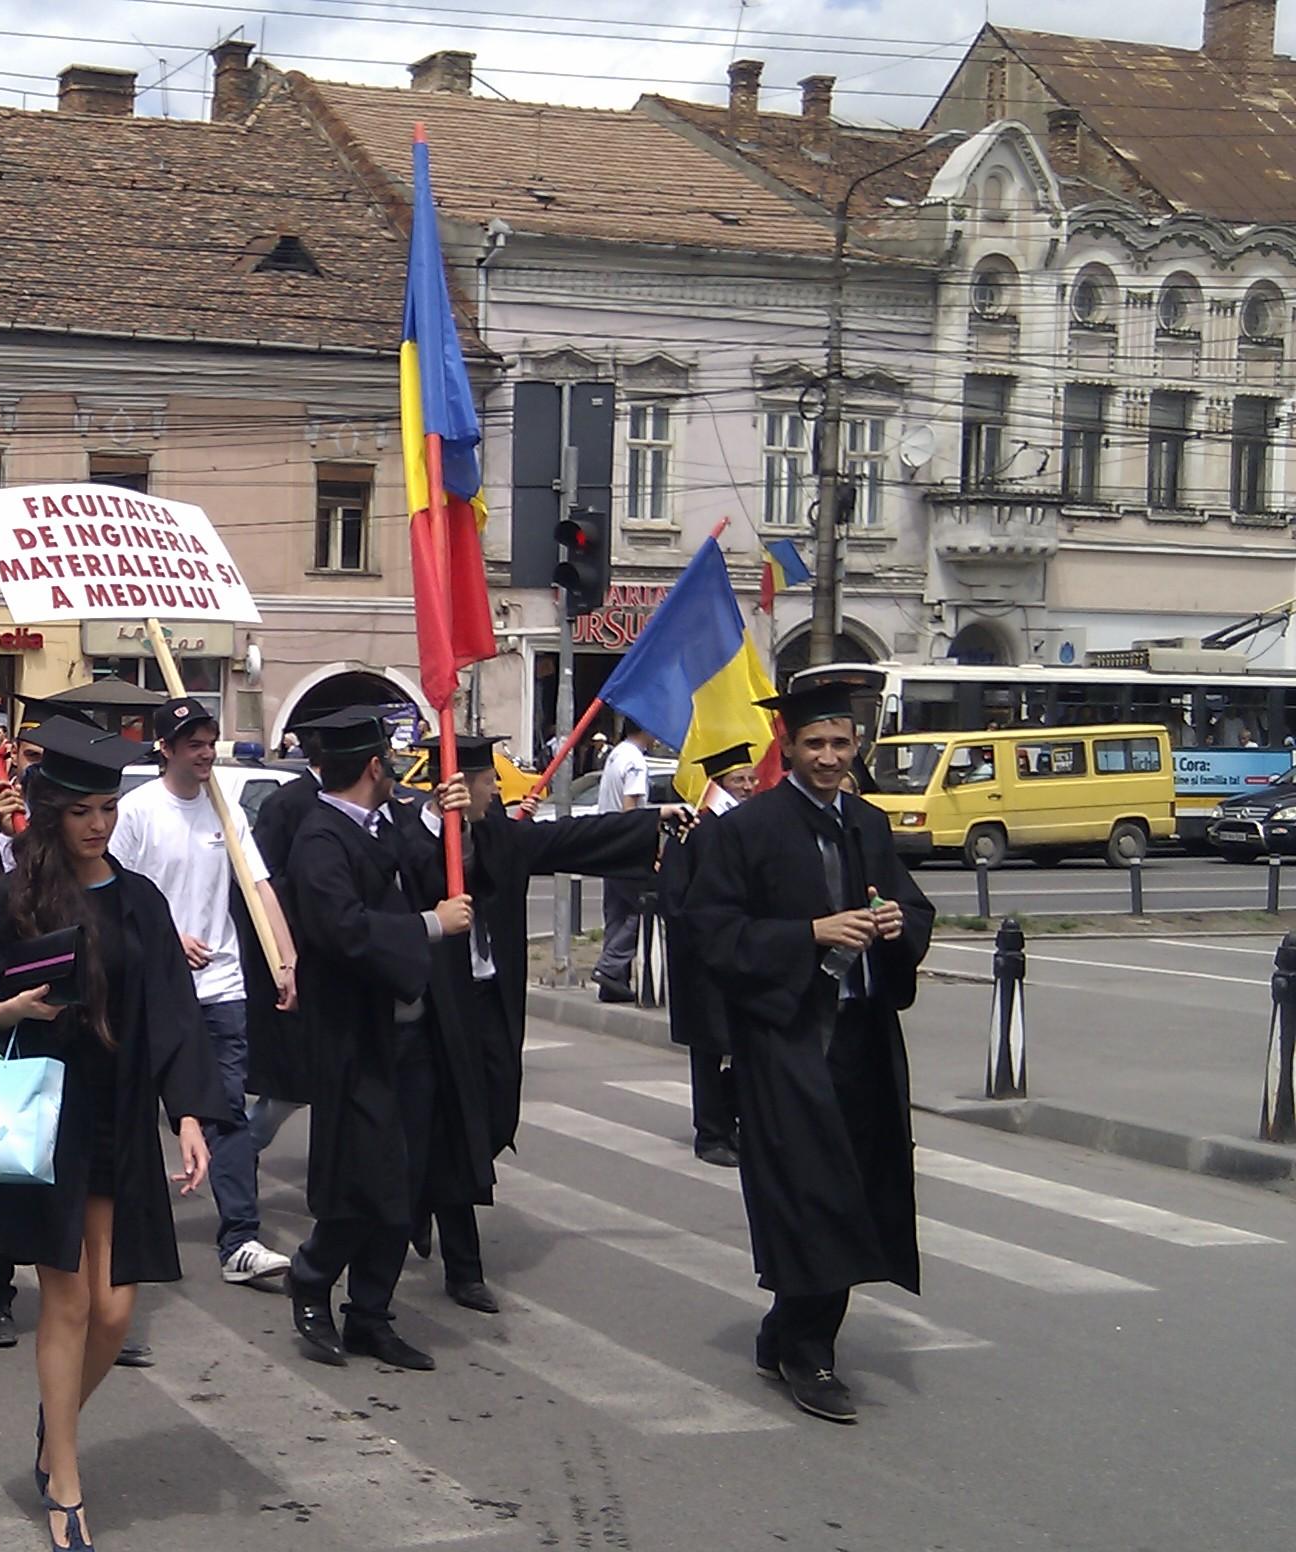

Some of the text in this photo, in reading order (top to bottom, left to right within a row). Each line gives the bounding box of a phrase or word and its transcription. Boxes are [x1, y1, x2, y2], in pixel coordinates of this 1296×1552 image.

[22, 494, 179, 527] FACULTATEA
[12, 523, 209, 556] DE INGINERIA
[51, 583, 221, 610] A MEDIULUI
[571, 606, 656, 649] URSU
[1179, 756, 1211, 772] Cora:
